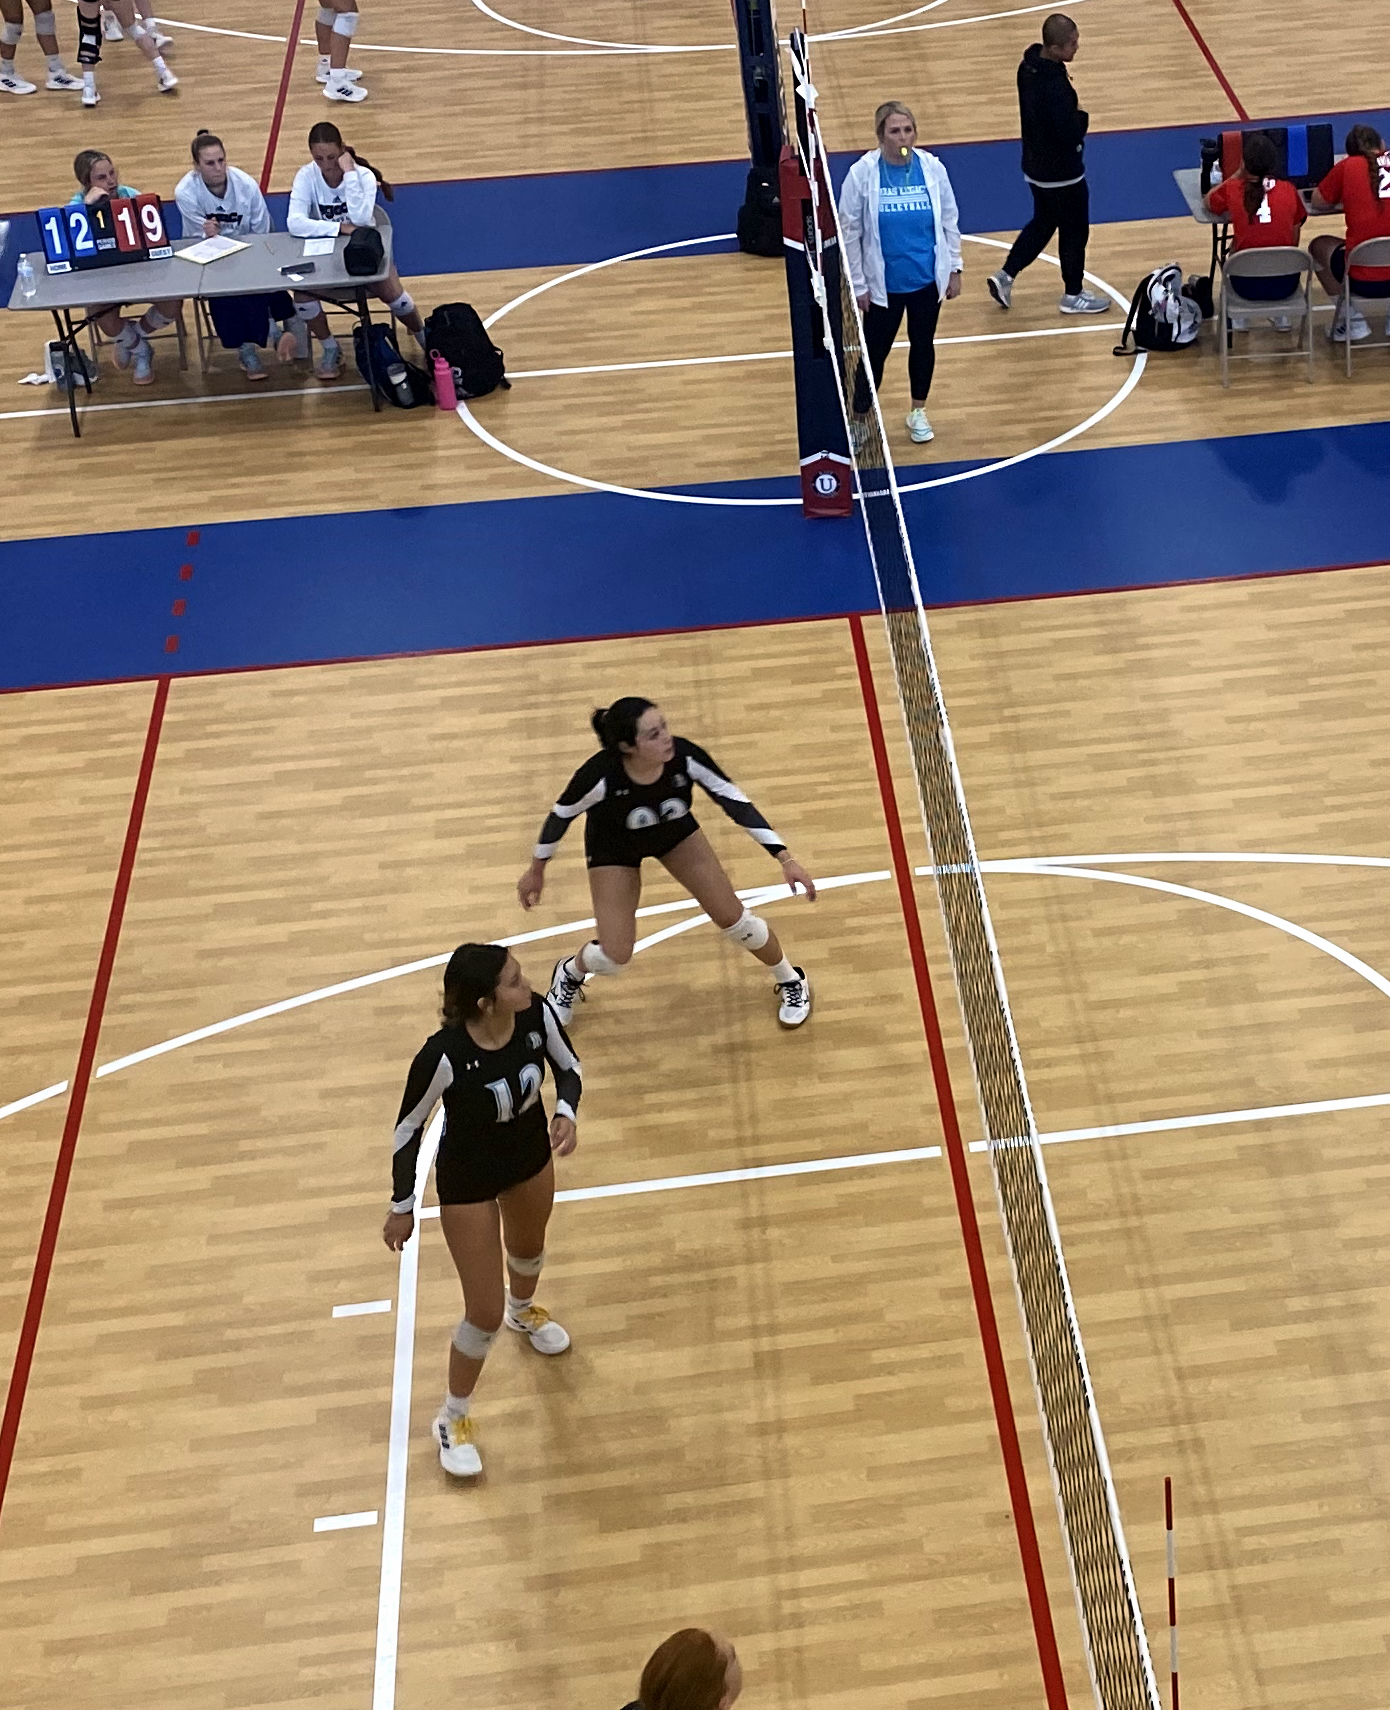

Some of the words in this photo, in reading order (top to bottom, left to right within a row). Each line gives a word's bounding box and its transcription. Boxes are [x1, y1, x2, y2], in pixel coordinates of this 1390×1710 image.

[96, 210, 105, 229] 1
[117, 204, 163, 246] 19
[879, 202, 932, 213] OLLEYBALL
[45, 212, 94, 254] 12
[483, 1063, 543, 1123] 12
